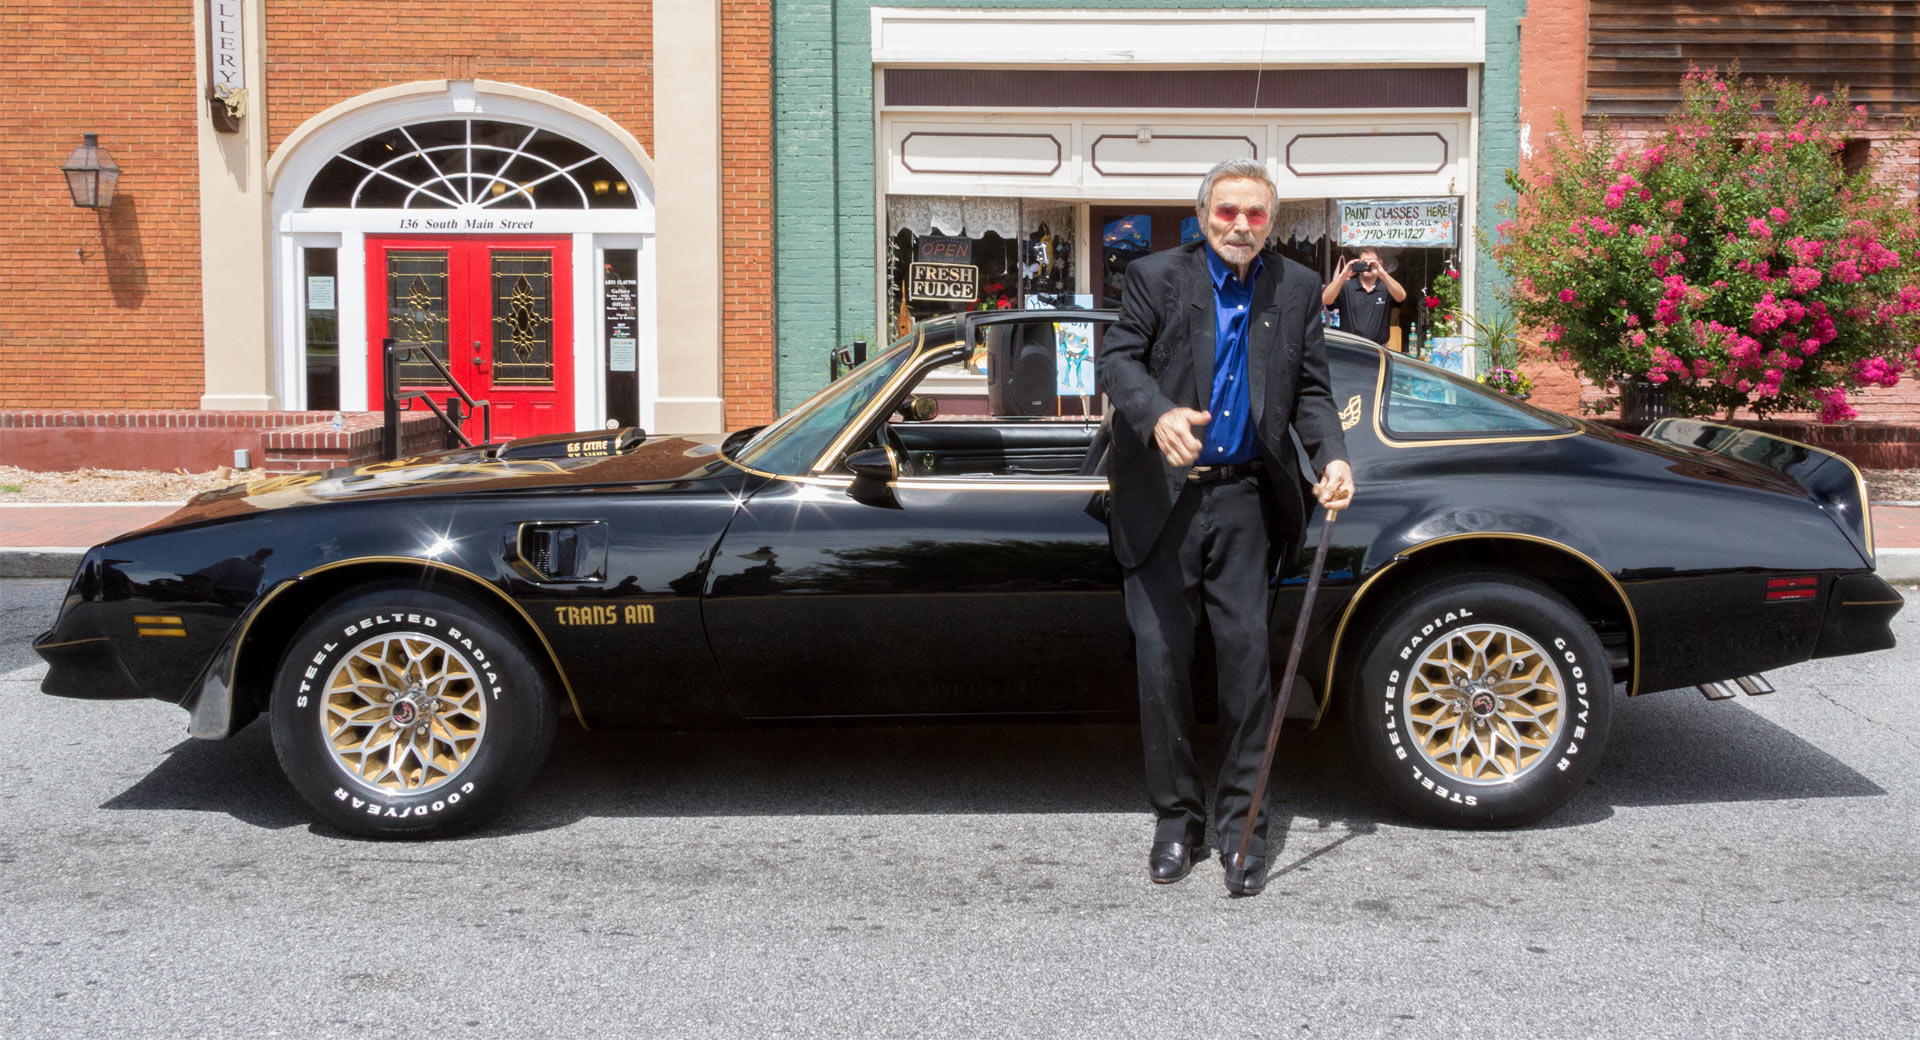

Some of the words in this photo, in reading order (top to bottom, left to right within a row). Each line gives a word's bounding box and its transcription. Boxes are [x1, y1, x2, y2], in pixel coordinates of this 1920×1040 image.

[217, 0, 238, 84] LLERY
[1344, 207, 1371, 220] PAINT
[1375, 206, 1419, 219] CLASSES
[1426, 204, 1451, 218] HERE!
[1415, 219, 1433, 227] CALL
[399, 219, 419, 229] 136
[425, 219, 458, 229] South
[464, 219, 494, 229] Main
[500, 219, 534, 229] Street
[921, 243, 969, 257] OPEN
[914, 266, 973, 282] FRESH
[913, 281, 973, 298] FUDGE
[582, 440, 608, 451] LITRE
[554, 604, 617, 626] TRANS
[624, 604, 655, 624] AM
[1399, 608, 1473, 660] RADIAL
[296, 641, 338, 708] STEEL
[344, 613, 437, 637] BELTED
[448, 627, 503, 700] RADIAL
[1384, 669, 1408, 760] BELTED
[1554, 637, 1590, 772] GOODYEAR
[1412, 765, 1478, 806] STEEL
[333, 781, 475, 818] GOODYEAR
